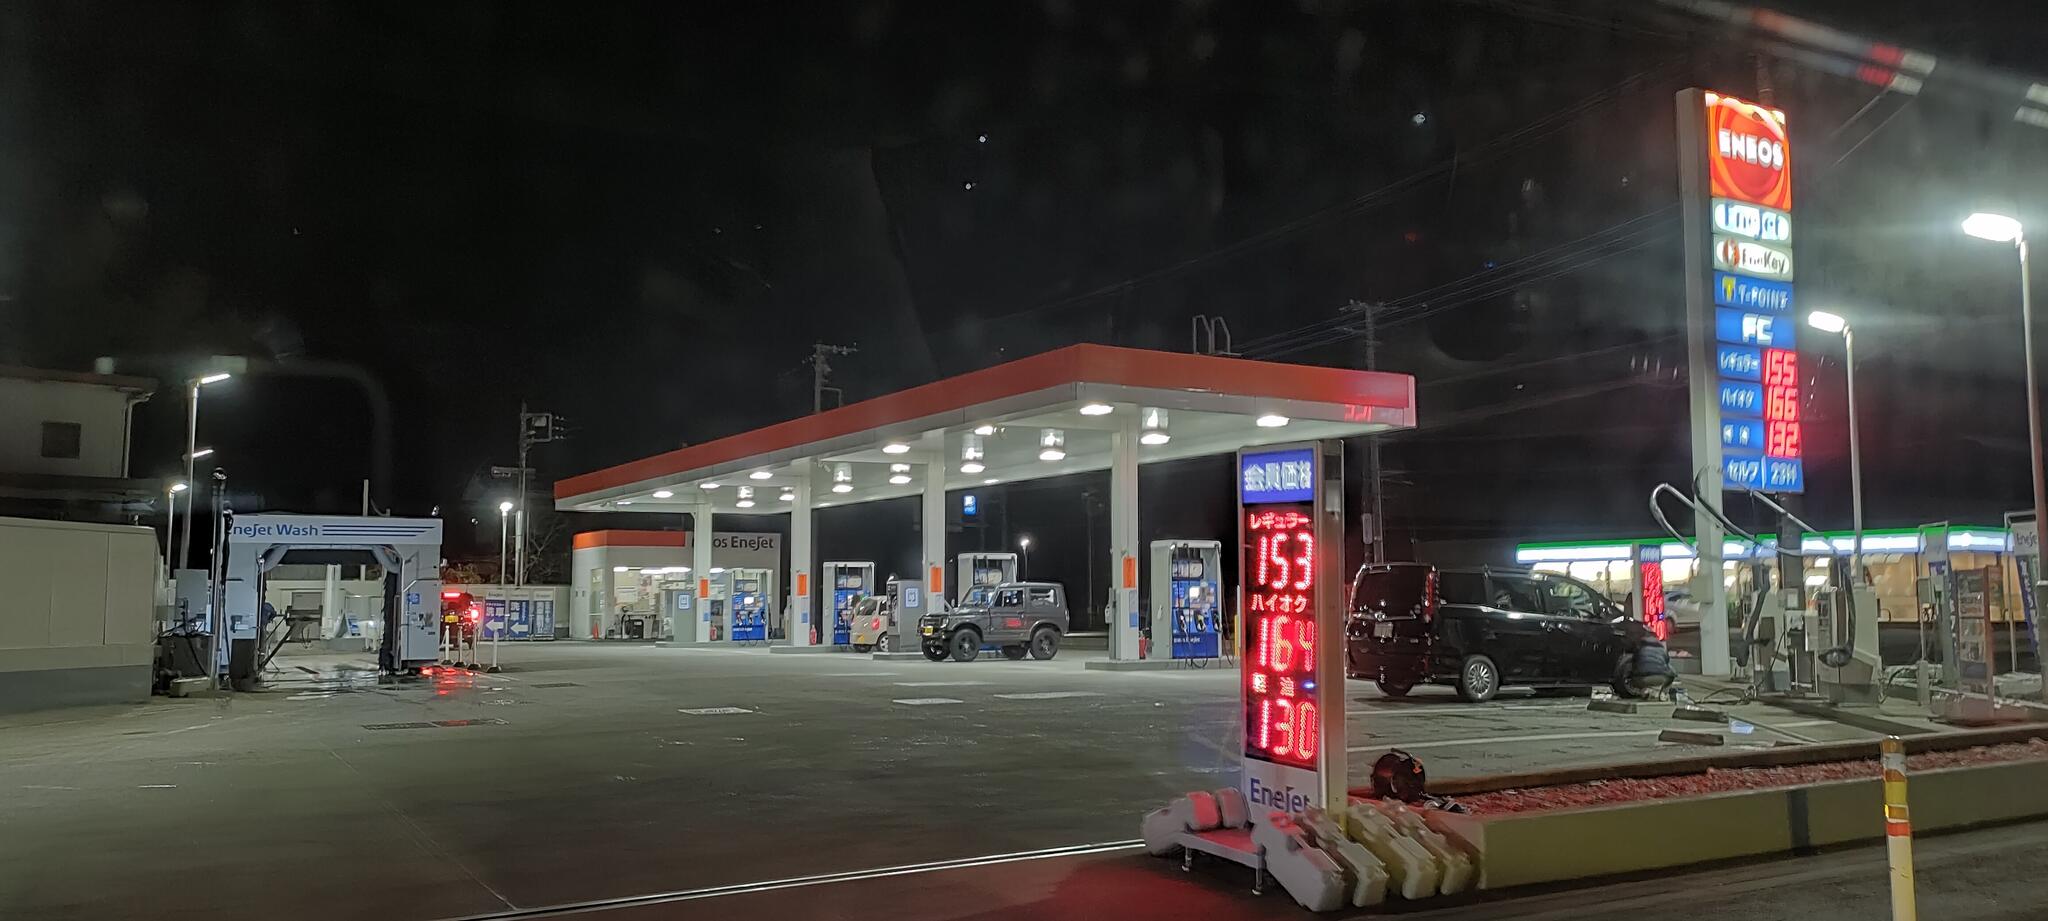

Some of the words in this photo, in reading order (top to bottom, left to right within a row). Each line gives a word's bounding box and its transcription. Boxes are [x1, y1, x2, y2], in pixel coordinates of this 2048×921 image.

[1719, 128, 1784, 171] ENEOS
[1764, 348, 1797, 386] 155
[1766, 384, 1799, 421] 166
[1768, 420, 1800, 457] 132
[276, 524, 318, 536] Wash
[1250, 511, 1310, 530] レギュラー
[1258, 532, 1313, 591] 153
[1250, 594, 1309, 613] ハイオク
[1260, 615, 1314, 673] 164
[1259, 699, 1317, 760] 130
